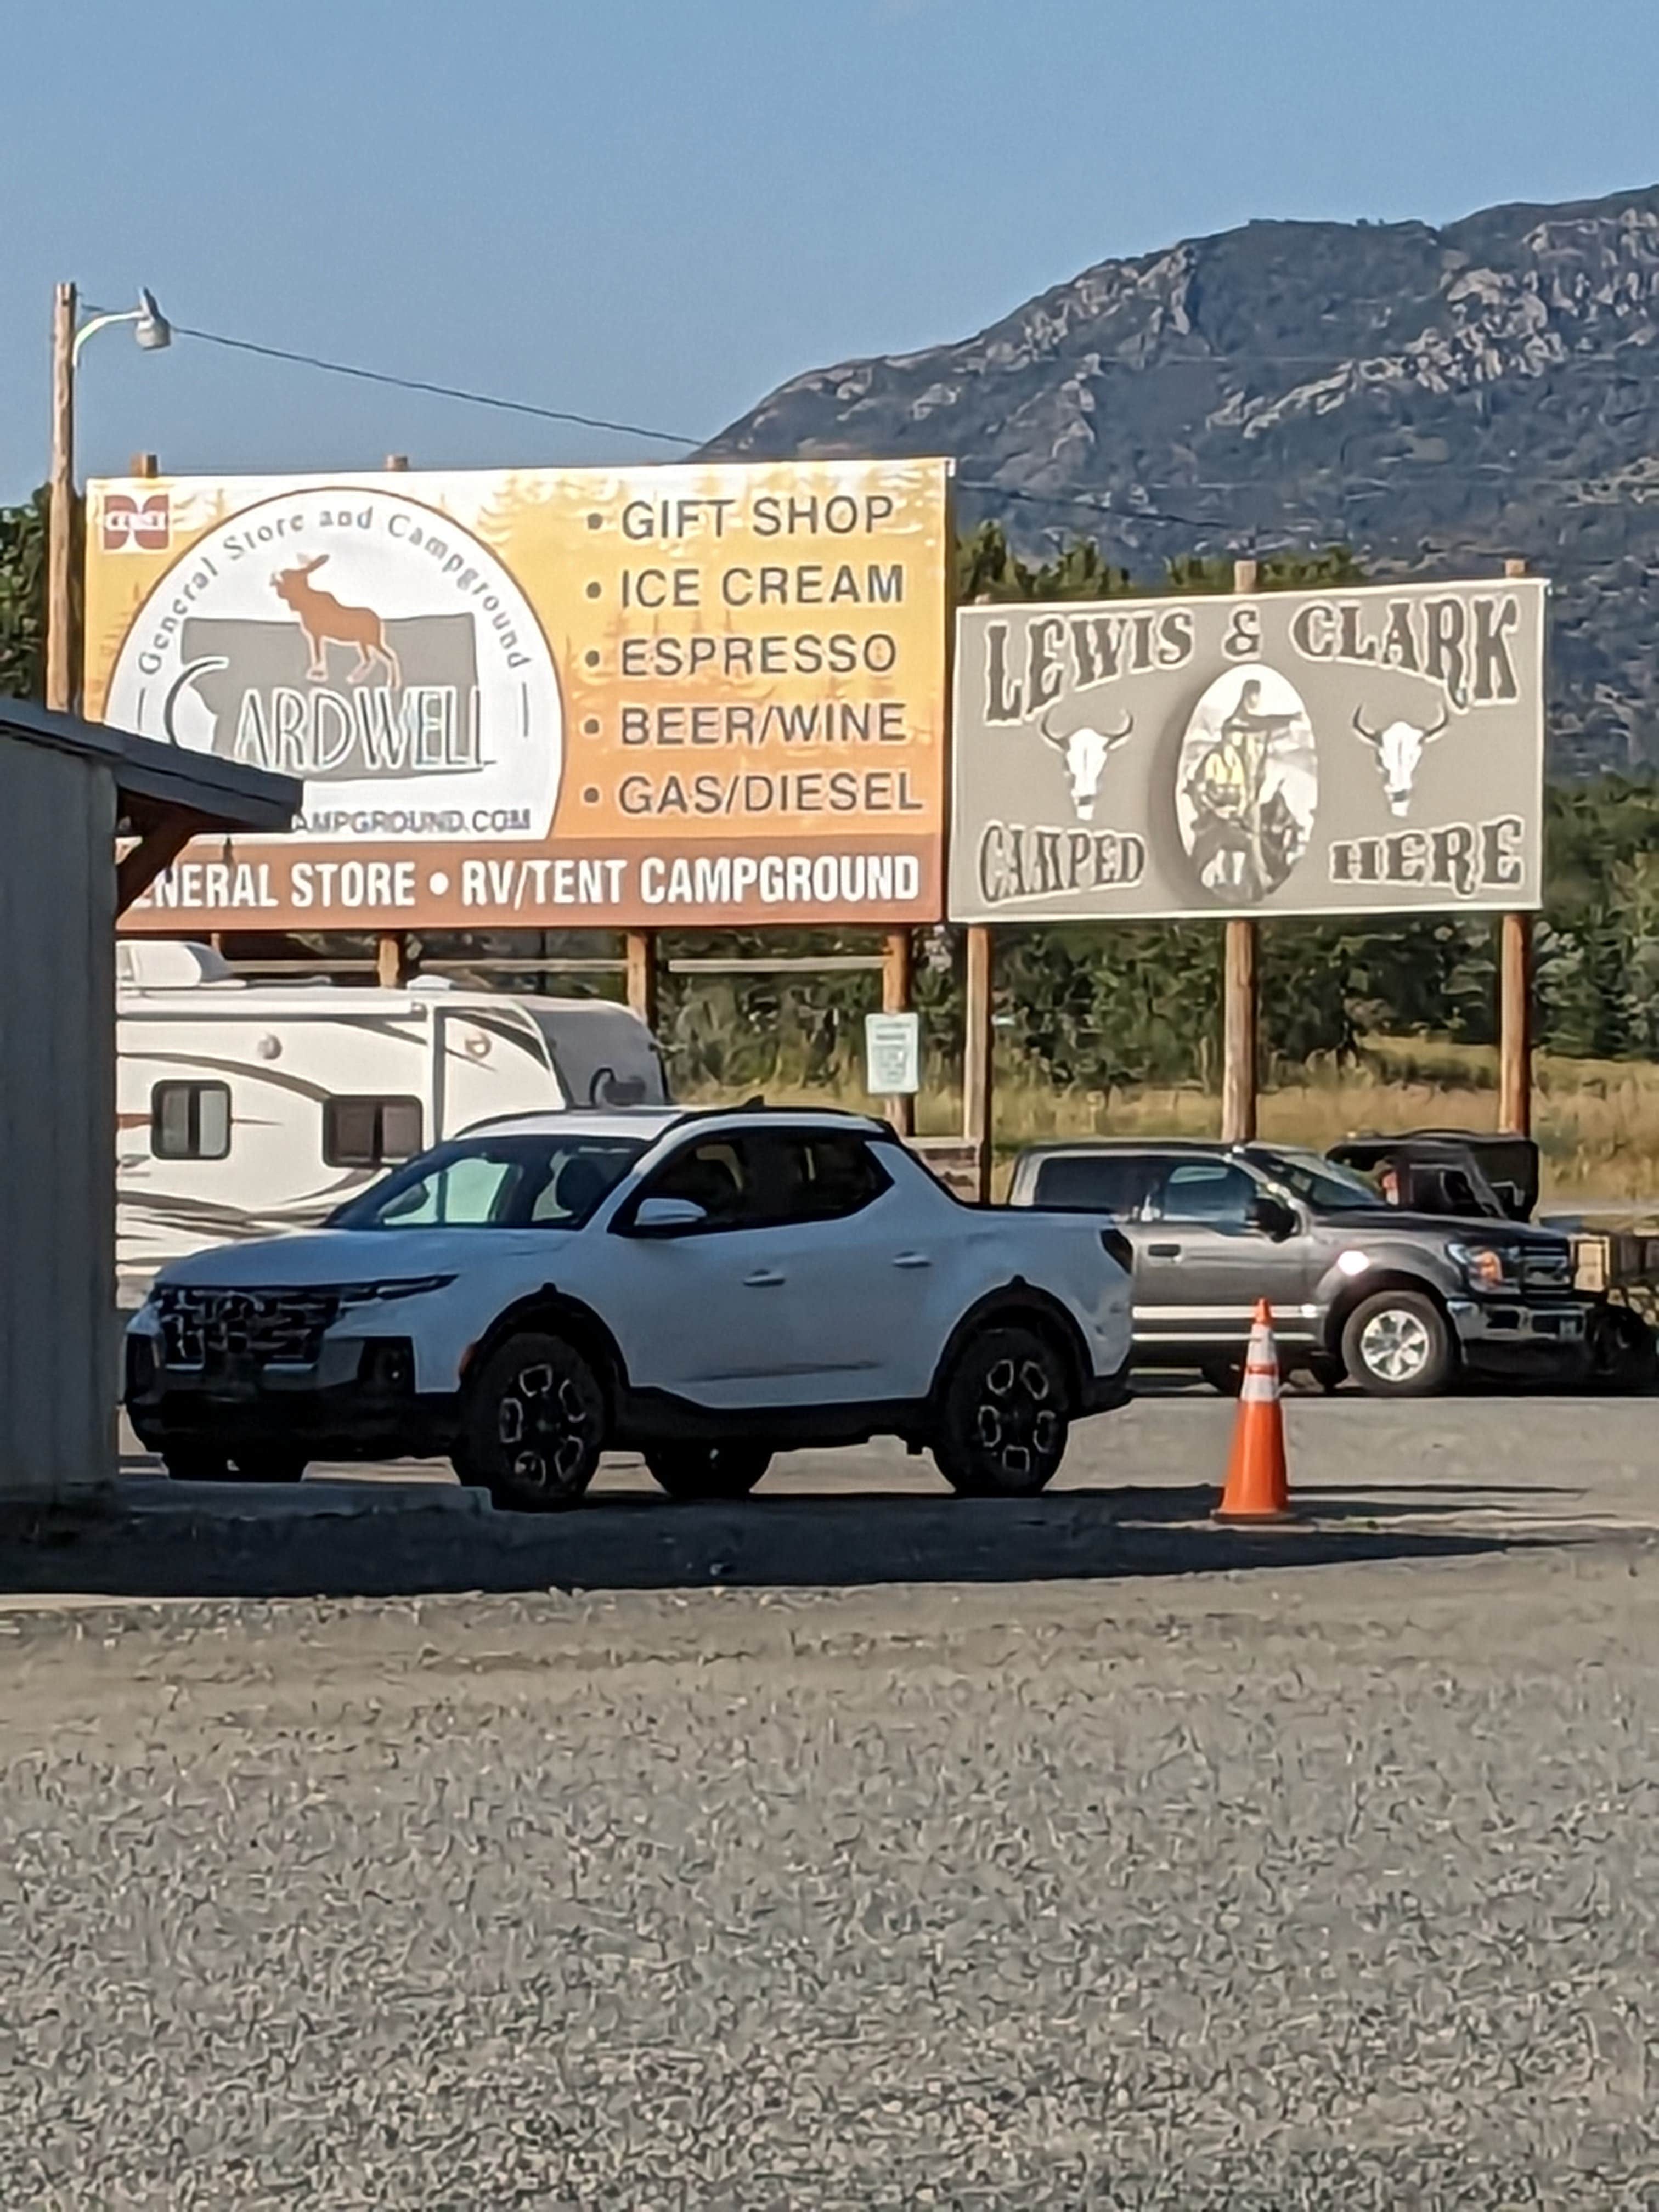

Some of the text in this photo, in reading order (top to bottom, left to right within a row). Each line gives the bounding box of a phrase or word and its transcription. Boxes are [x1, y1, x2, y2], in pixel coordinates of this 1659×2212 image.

[622, 495, 893, 539] GIFT SHOP
[138, 506, 532, 675] General Store and Campground
[622, 563, 904, 607] ICE CREAM
[622, 633, 897, 676] ESPRESSO
[985, 594, 1521, 726] LEWIS & CLARK
[621, 702, 907, 745] BEER/WINE
[619, 772, 923, 814] GAS/DIESEL
[292, 808, 531, 834] AMPGROUND.COM
[980, 820, 1147, 907] CAMPED
[1328, 814, 1525, 900] HERE
[131, 855, 919, 911] NERAL STORE RV/TENT CAMPGROUND
